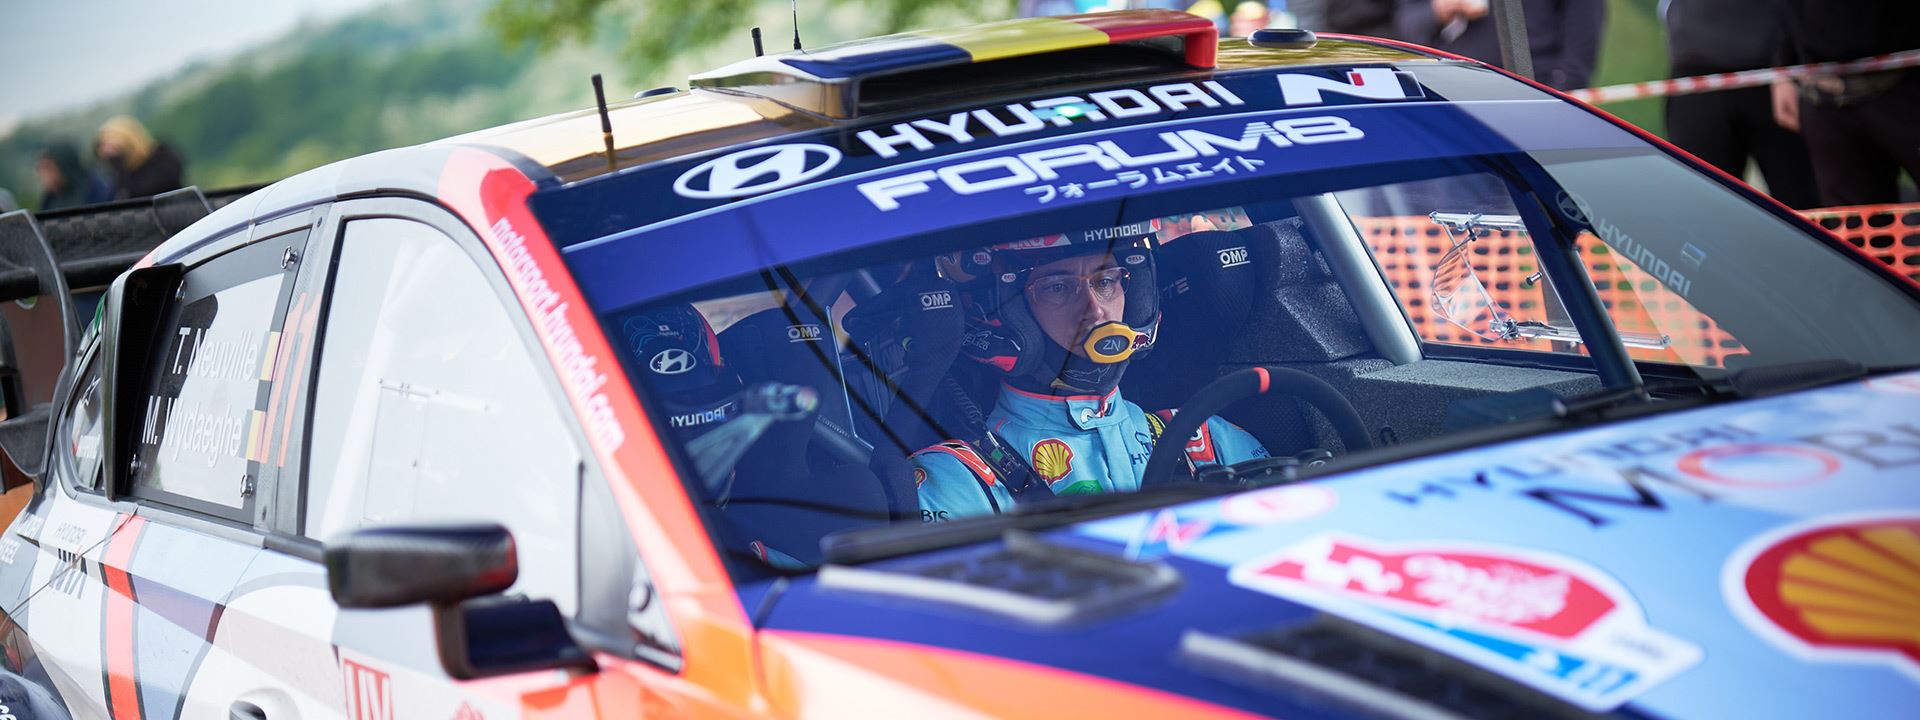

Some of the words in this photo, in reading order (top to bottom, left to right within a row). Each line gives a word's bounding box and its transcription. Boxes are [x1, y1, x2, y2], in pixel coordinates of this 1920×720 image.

[857, 80, 1245, 158] HYUNDAI
[857, 116, 1365, 211] FORUM8
[1023, 154, 1266, 204] フォーラムエイト
[1084, 223, 1142, 242] HYUNDAI
[1219, 248, 1248, 265] OMP
[1598, 218, 1692, 298] HYUNDAI
[921, 292, 952, 307] OMP
[173, 327, 191, 375] T.
[186, 327, 258, 382] Neuville
[491, 216, 626, 455] motorsport.hyundai.com
[788, 326, 821, 339] OMP
[142, 395, 161, 446] M.
[164, 397, 243, 469] Wydaeghe
[1520, 420, 1920, 527] MOB
[920, 509, 949, 523] BIS
